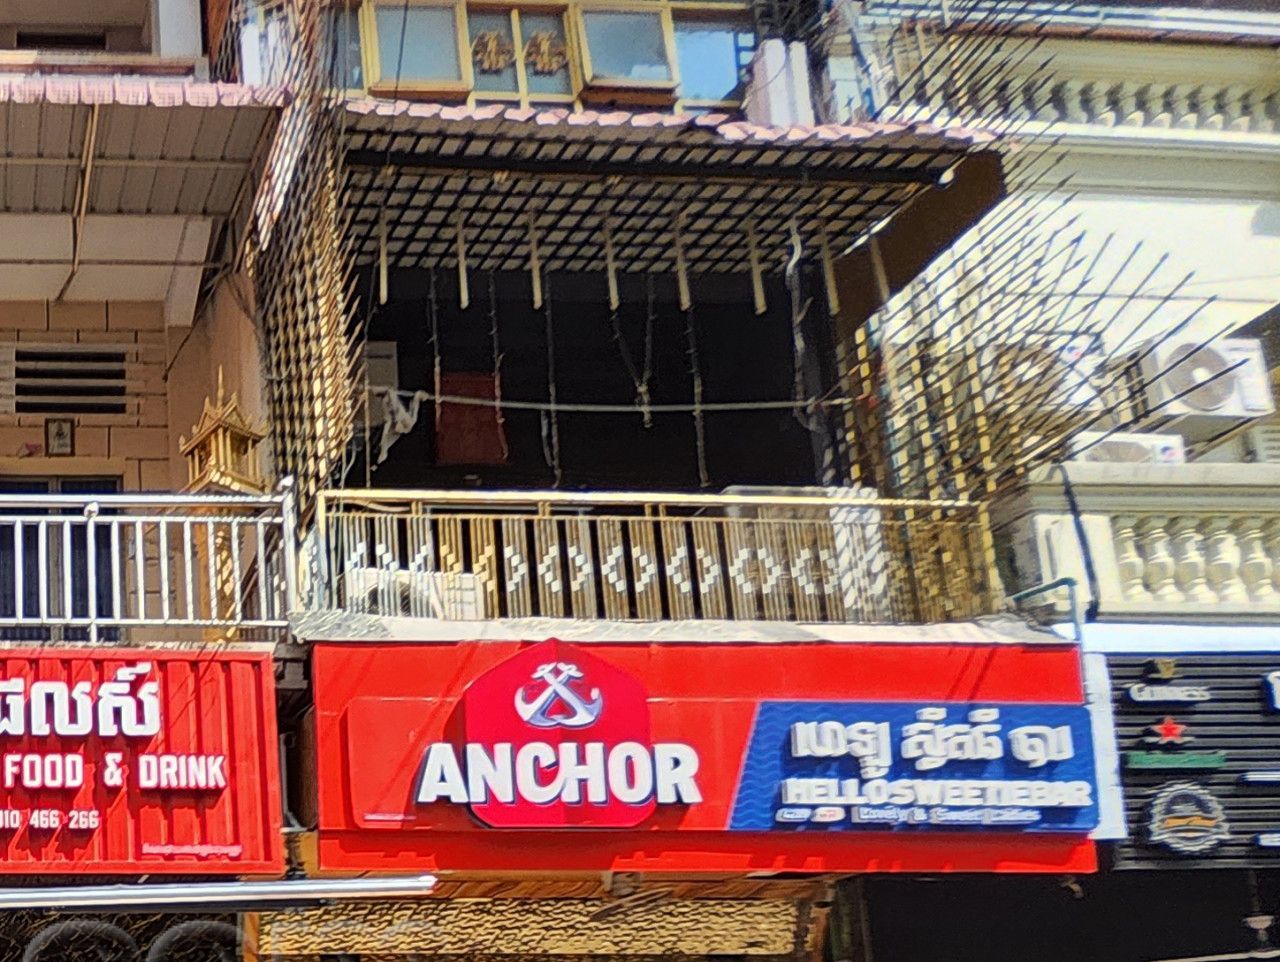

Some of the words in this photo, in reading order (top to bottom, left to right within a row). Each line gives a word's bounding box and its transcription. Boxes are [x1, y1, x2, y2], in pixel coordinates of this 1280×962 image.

[4, 753, 84, 789] FOOD
[104, 752, 123, 788] &
[139, 754, 227, 790] DRINK
[416, 741, 704, 804] ANCHOR
[29, 810, 61, 830] 466
[68, 810, 100, 830] 266
